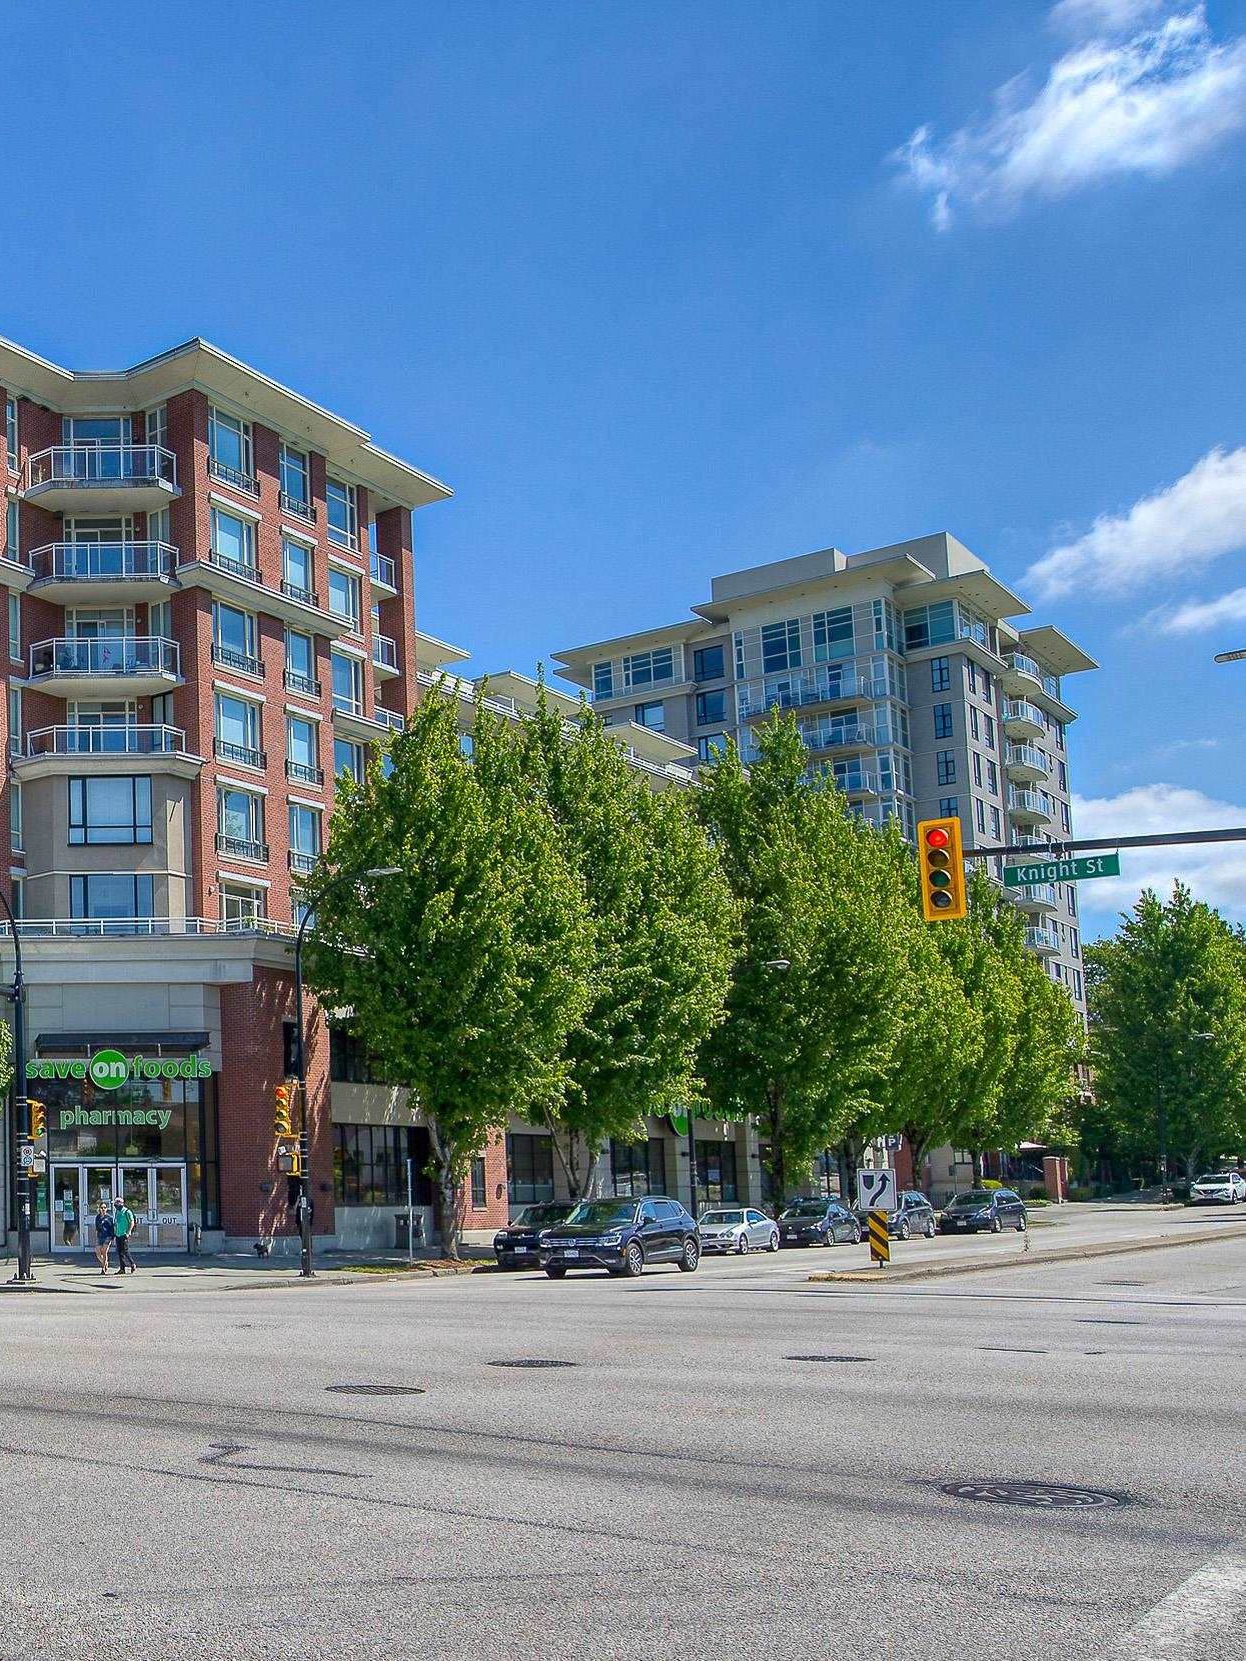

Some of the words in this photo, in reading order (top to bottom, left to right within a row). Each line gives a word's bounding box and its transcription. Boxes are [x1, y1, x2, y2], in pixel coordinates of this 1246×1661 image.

[1017, 861, 1078, 881] Knight
[1086, 858, 1104, 874] St
[26, 1060, 86, 1079] save
[92, 1061, 126, 1078] on
[133, 1055, 212, 1078] foods
[60, 1105, 172, 1130] pharmacy
